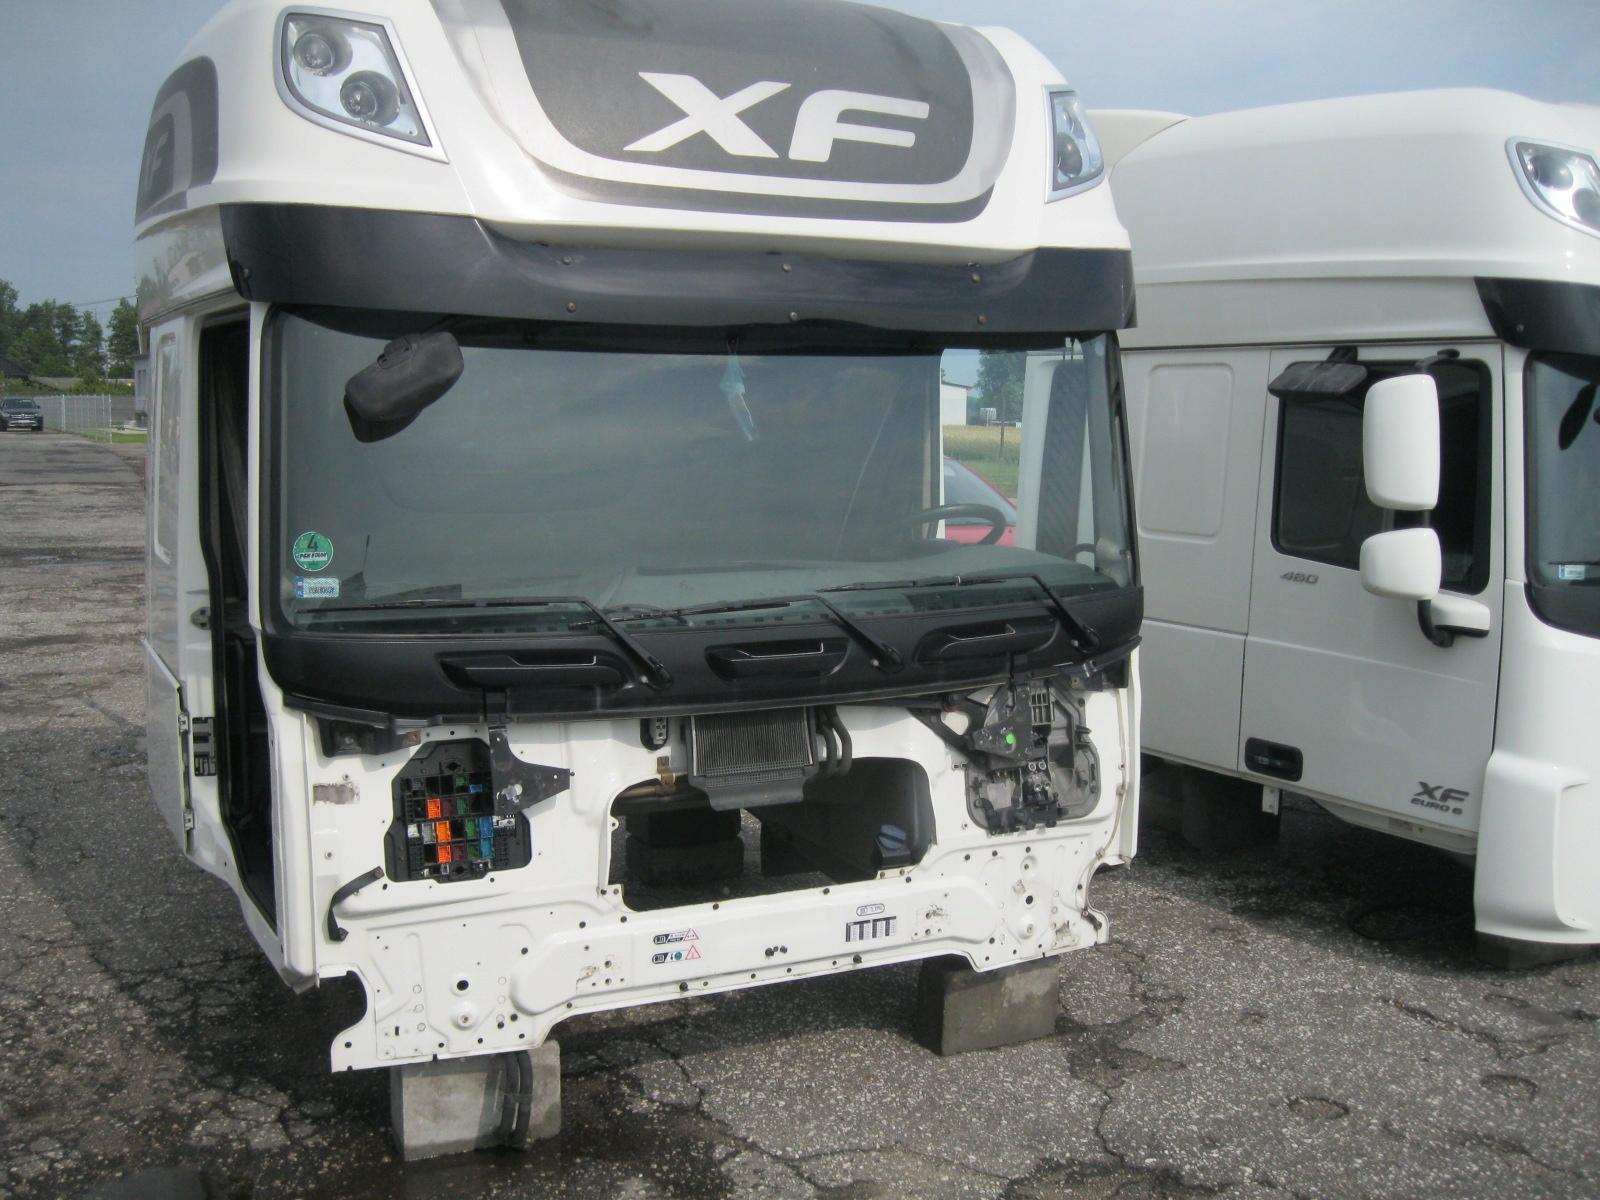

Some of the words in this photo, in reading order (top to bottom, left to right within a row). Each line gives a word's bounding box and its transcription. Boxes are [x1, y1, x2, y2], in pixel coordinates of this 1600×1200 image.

[623, 71, 930, 162] XF
[307, 534, 319, 551] 4
[1414, 781, 1469, 802] XF
[1411, 797, 1450, 811] EURO
